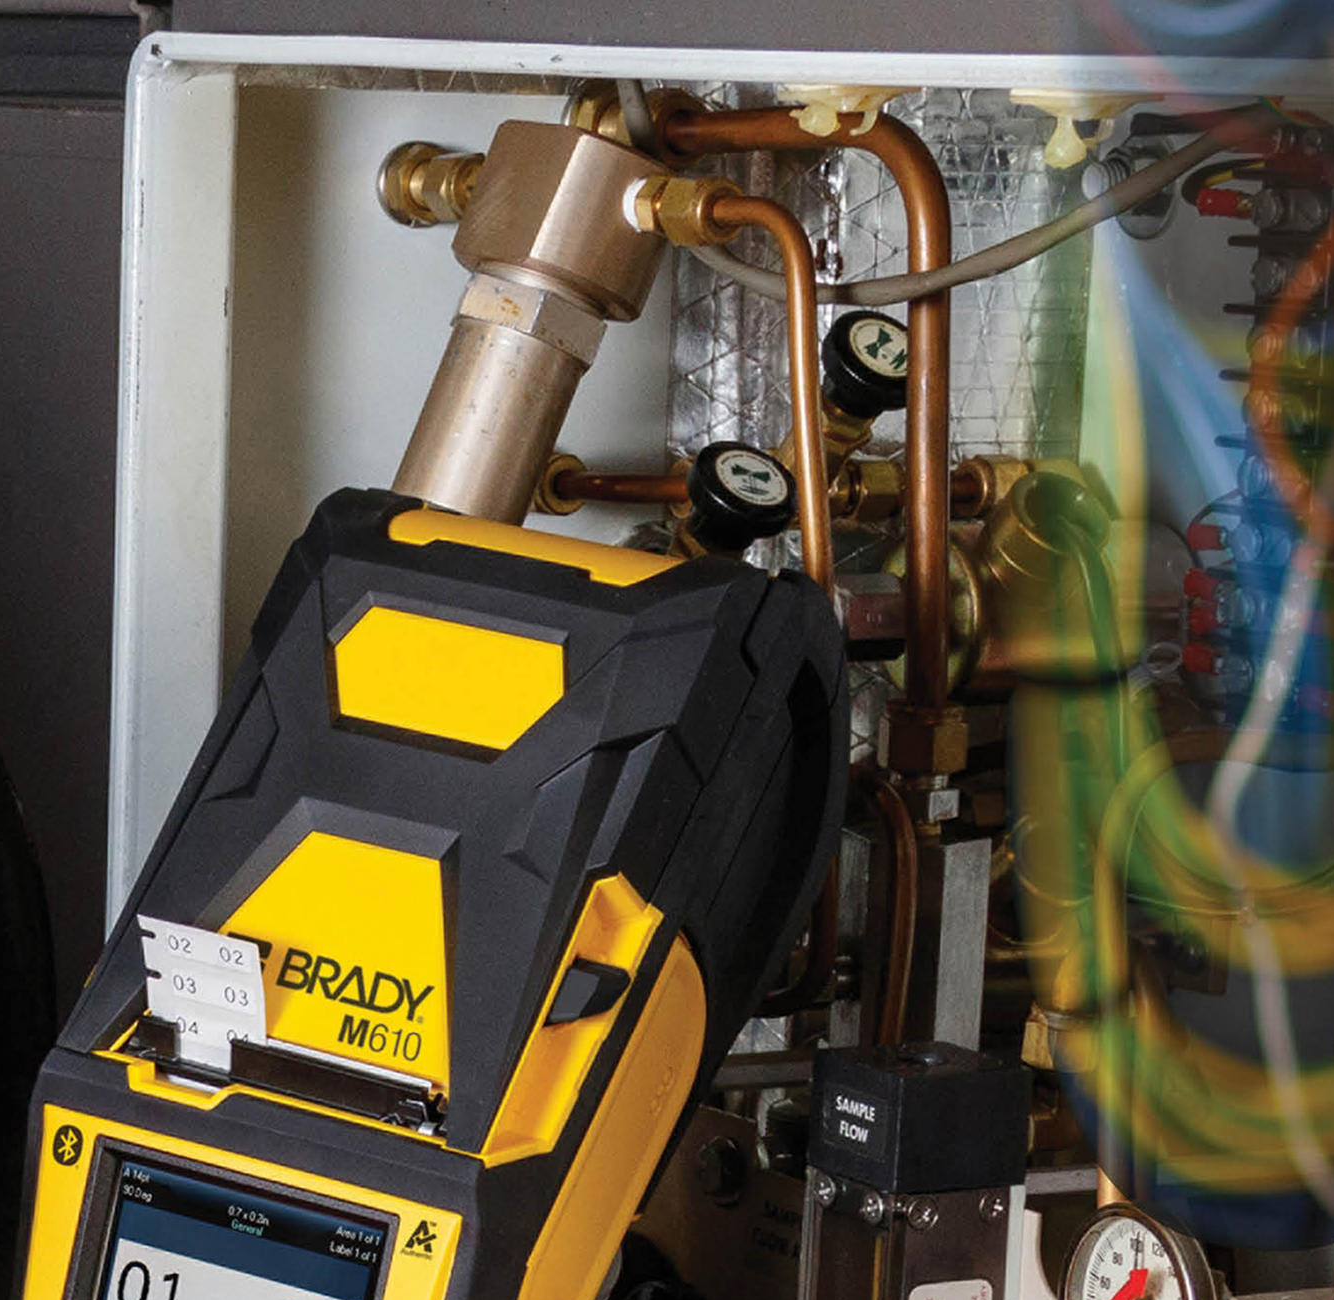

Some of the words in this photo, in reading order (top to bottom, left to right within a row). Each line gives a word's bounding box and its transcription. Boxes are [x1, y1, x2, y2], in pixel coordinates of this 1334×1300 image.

[168, 934, 192, 954] 02
[219, 946, 244, 966] 02
[173, 974, 197, 995] 03
[224, 986, 249, 1007] 03
[276, 947, 435, 1022] BRADY
[176, 1017, 198, 1035] 04
[337, 1014, 422, 1062] M610
[836, 1095, 875, 1122] SAMPLE
[839, 1120, 868, 1143] FLOW
[231, 1218, 264, 1236] General
